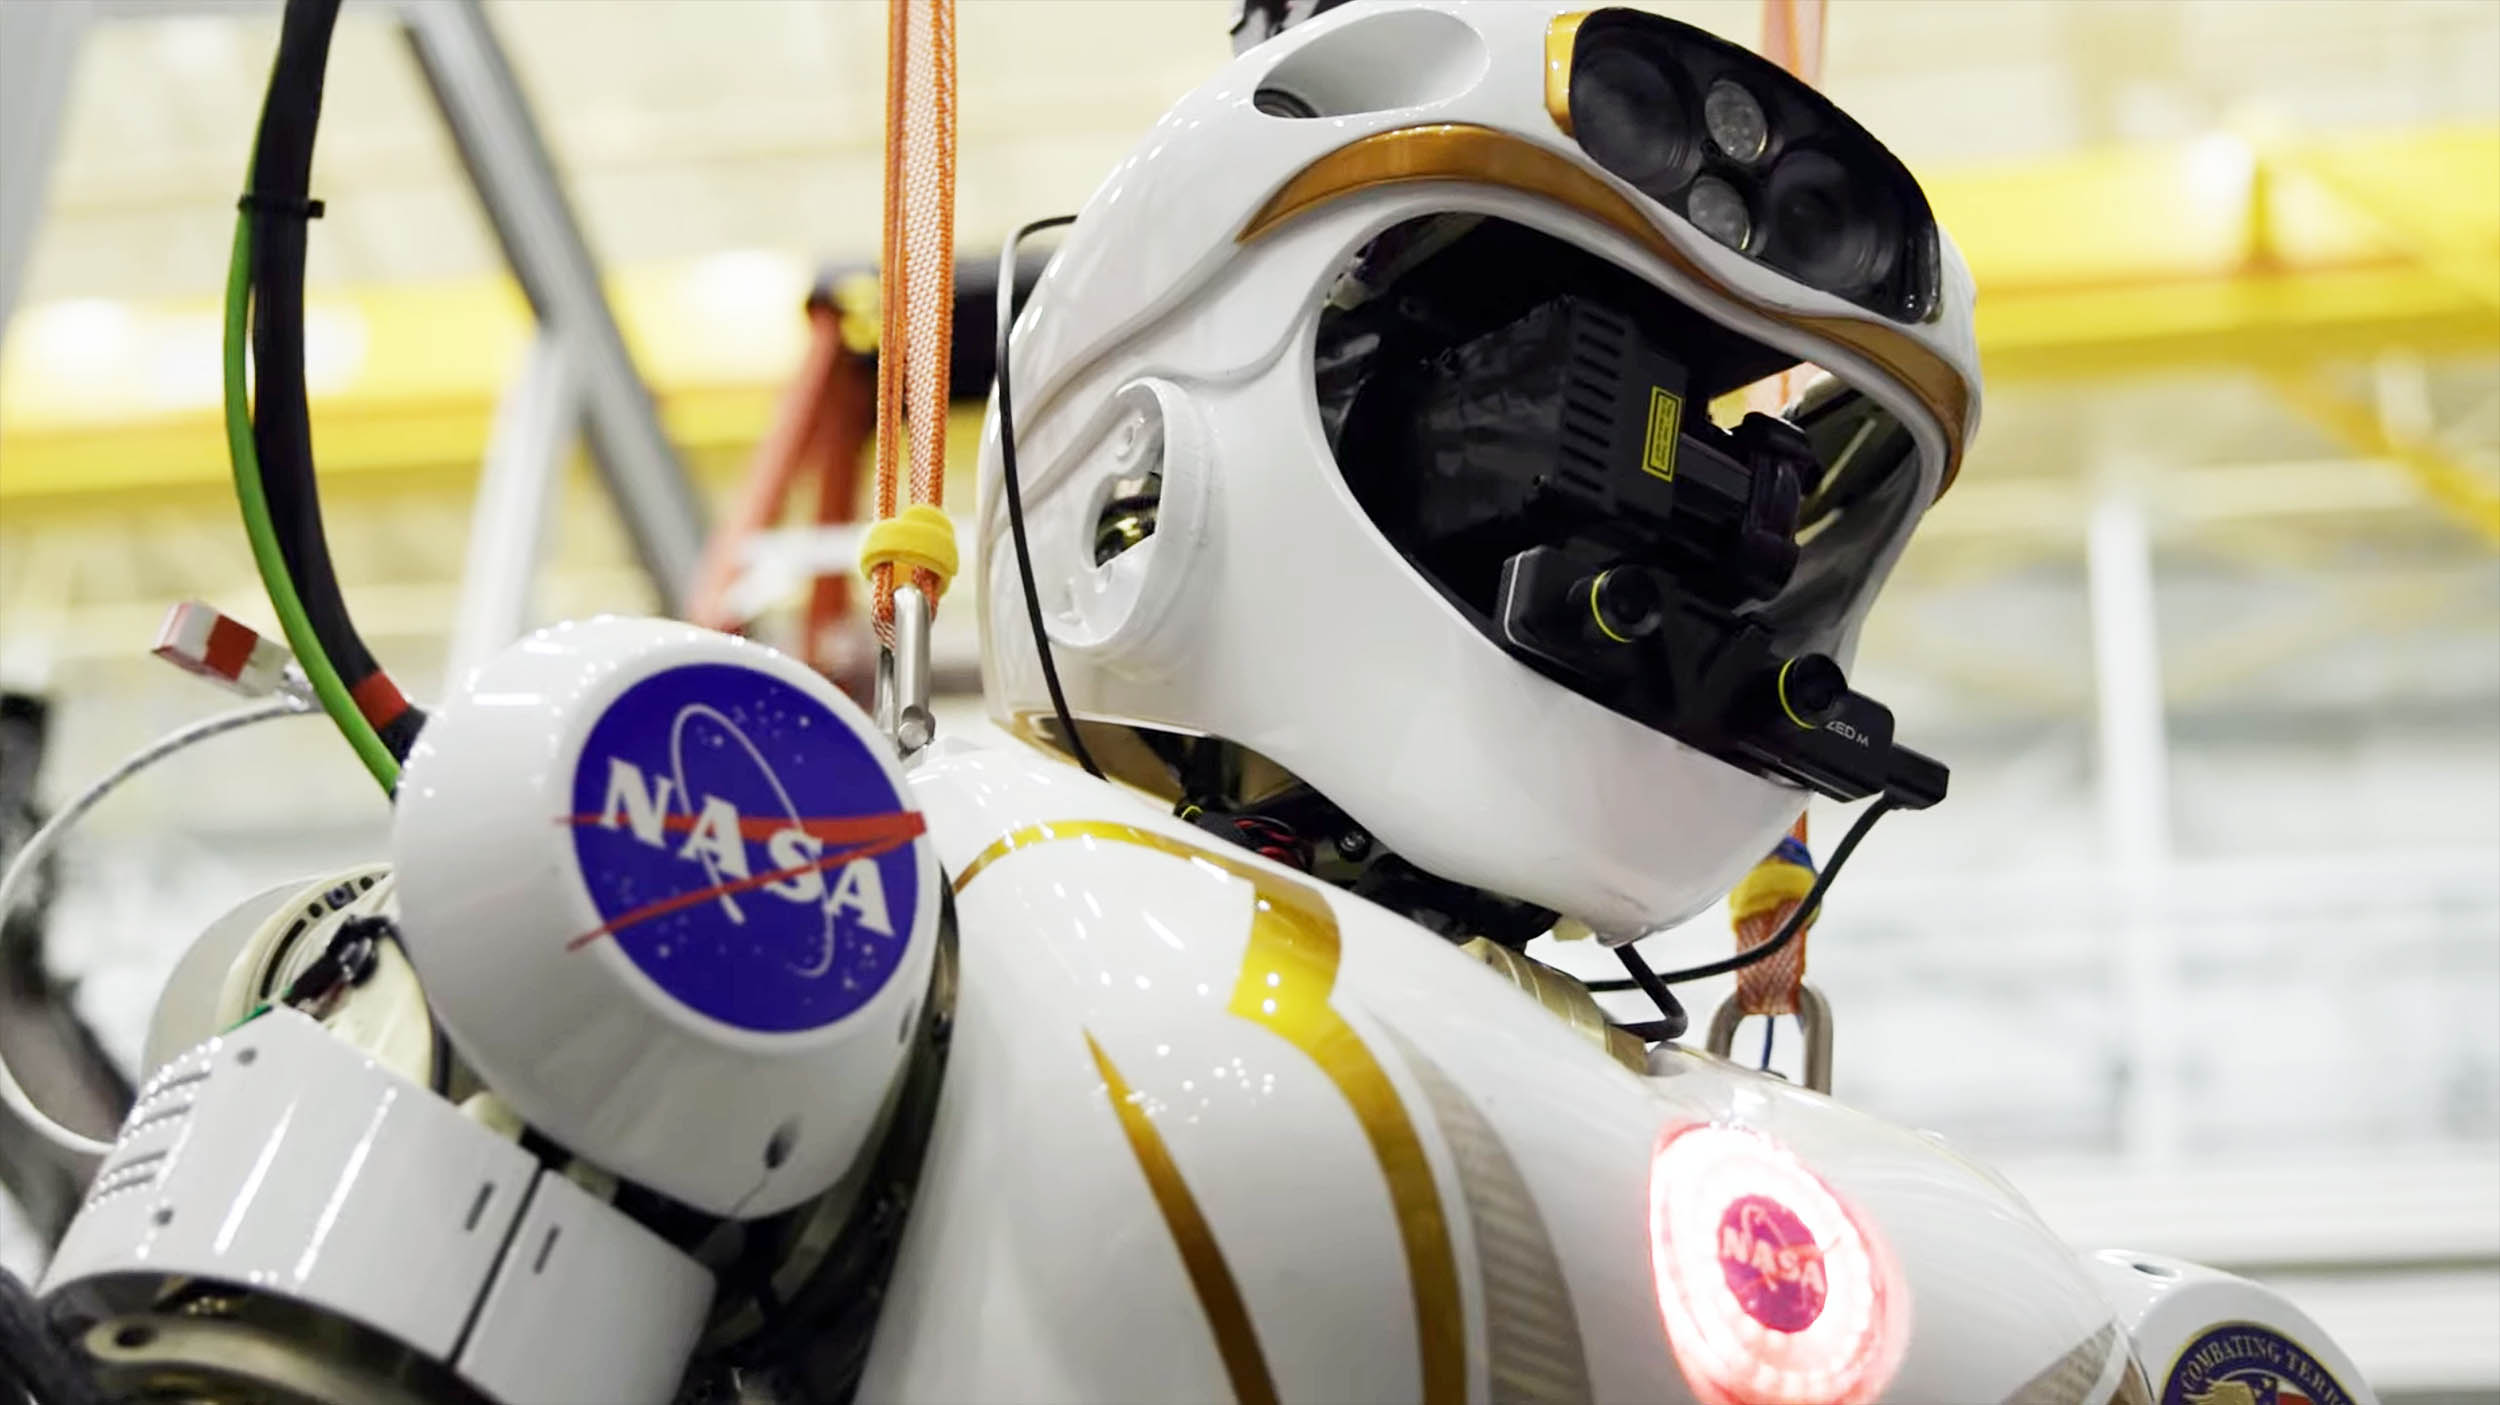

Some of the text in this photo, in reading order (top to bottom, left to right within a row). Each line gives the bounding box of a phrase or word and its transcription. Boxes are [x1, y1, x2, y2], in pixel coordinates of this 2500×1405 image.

[598, 756, 895, 937] NASA
[1721, 1225, 1825, 1294] NASA
[2181, 1335, 2281, 1391] COMBATING
